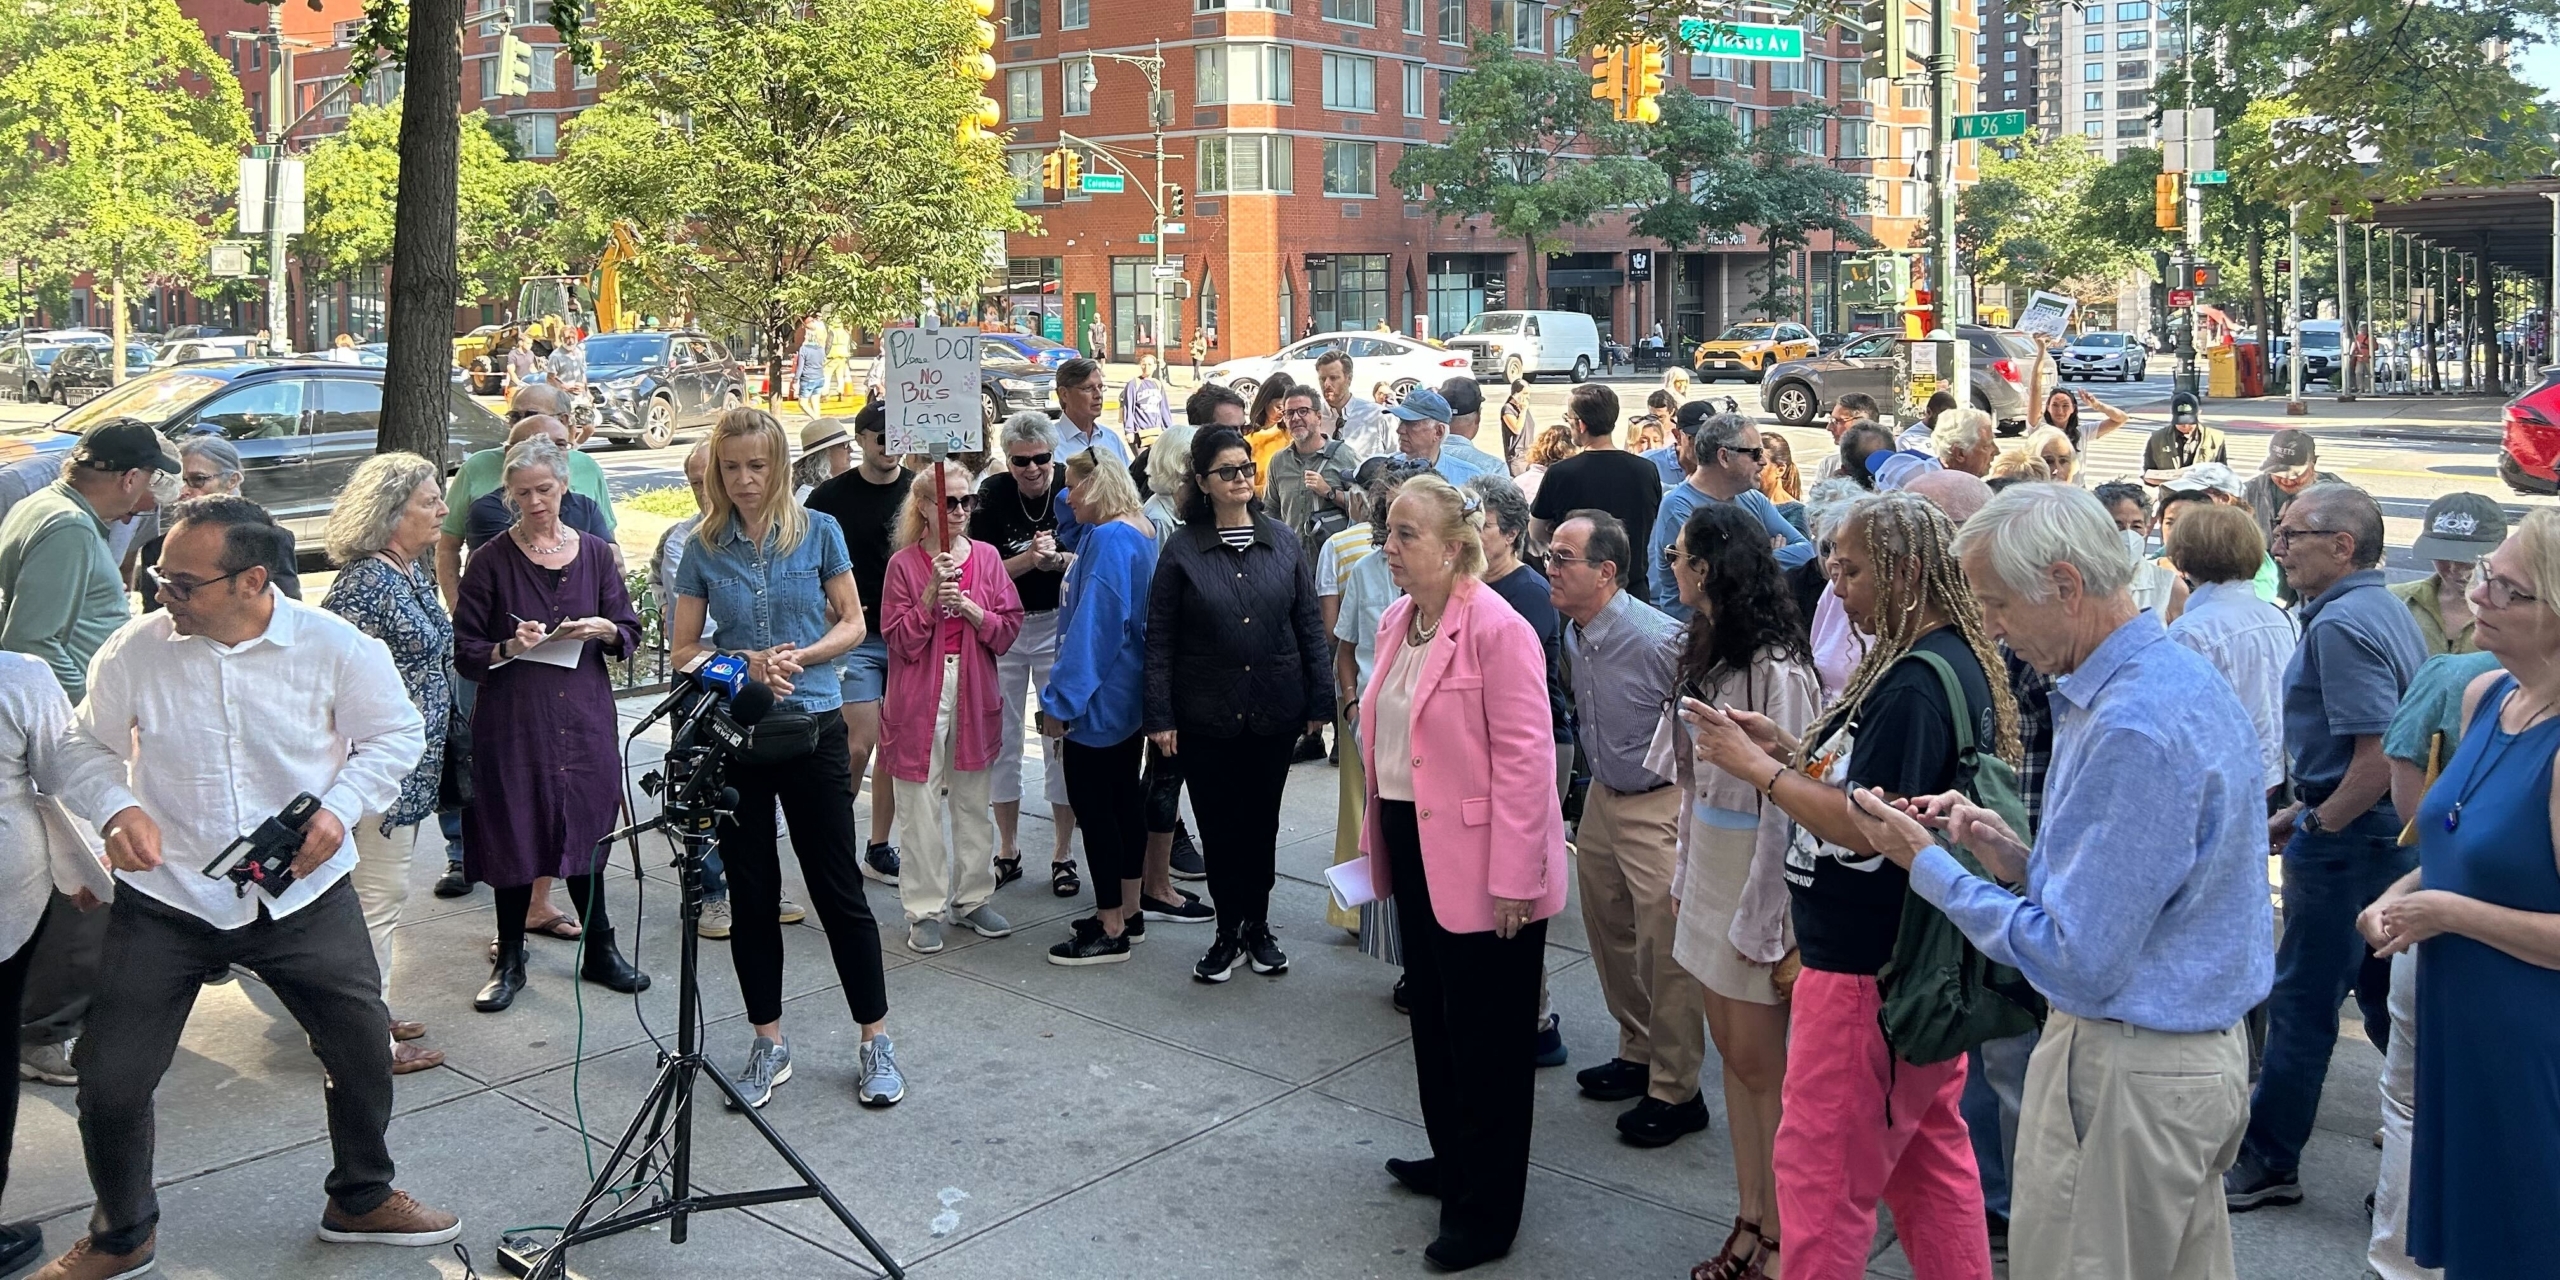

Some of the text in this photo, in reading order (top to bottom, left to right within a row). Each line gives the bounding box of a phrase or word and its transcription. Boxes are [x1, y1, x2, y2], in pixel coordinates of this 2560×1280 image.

[1768, 34, 1789, 52] Av
[1962, 114, 2018, 136] W 96 ST
[920, 368, 942, 384] NO
[901, 381, 950, 403] Bus
[903, 406, 961, 426] Lane
[712, 723, 731, 741] NEWS
[713, 714, 734, 735] SPECTRUM
